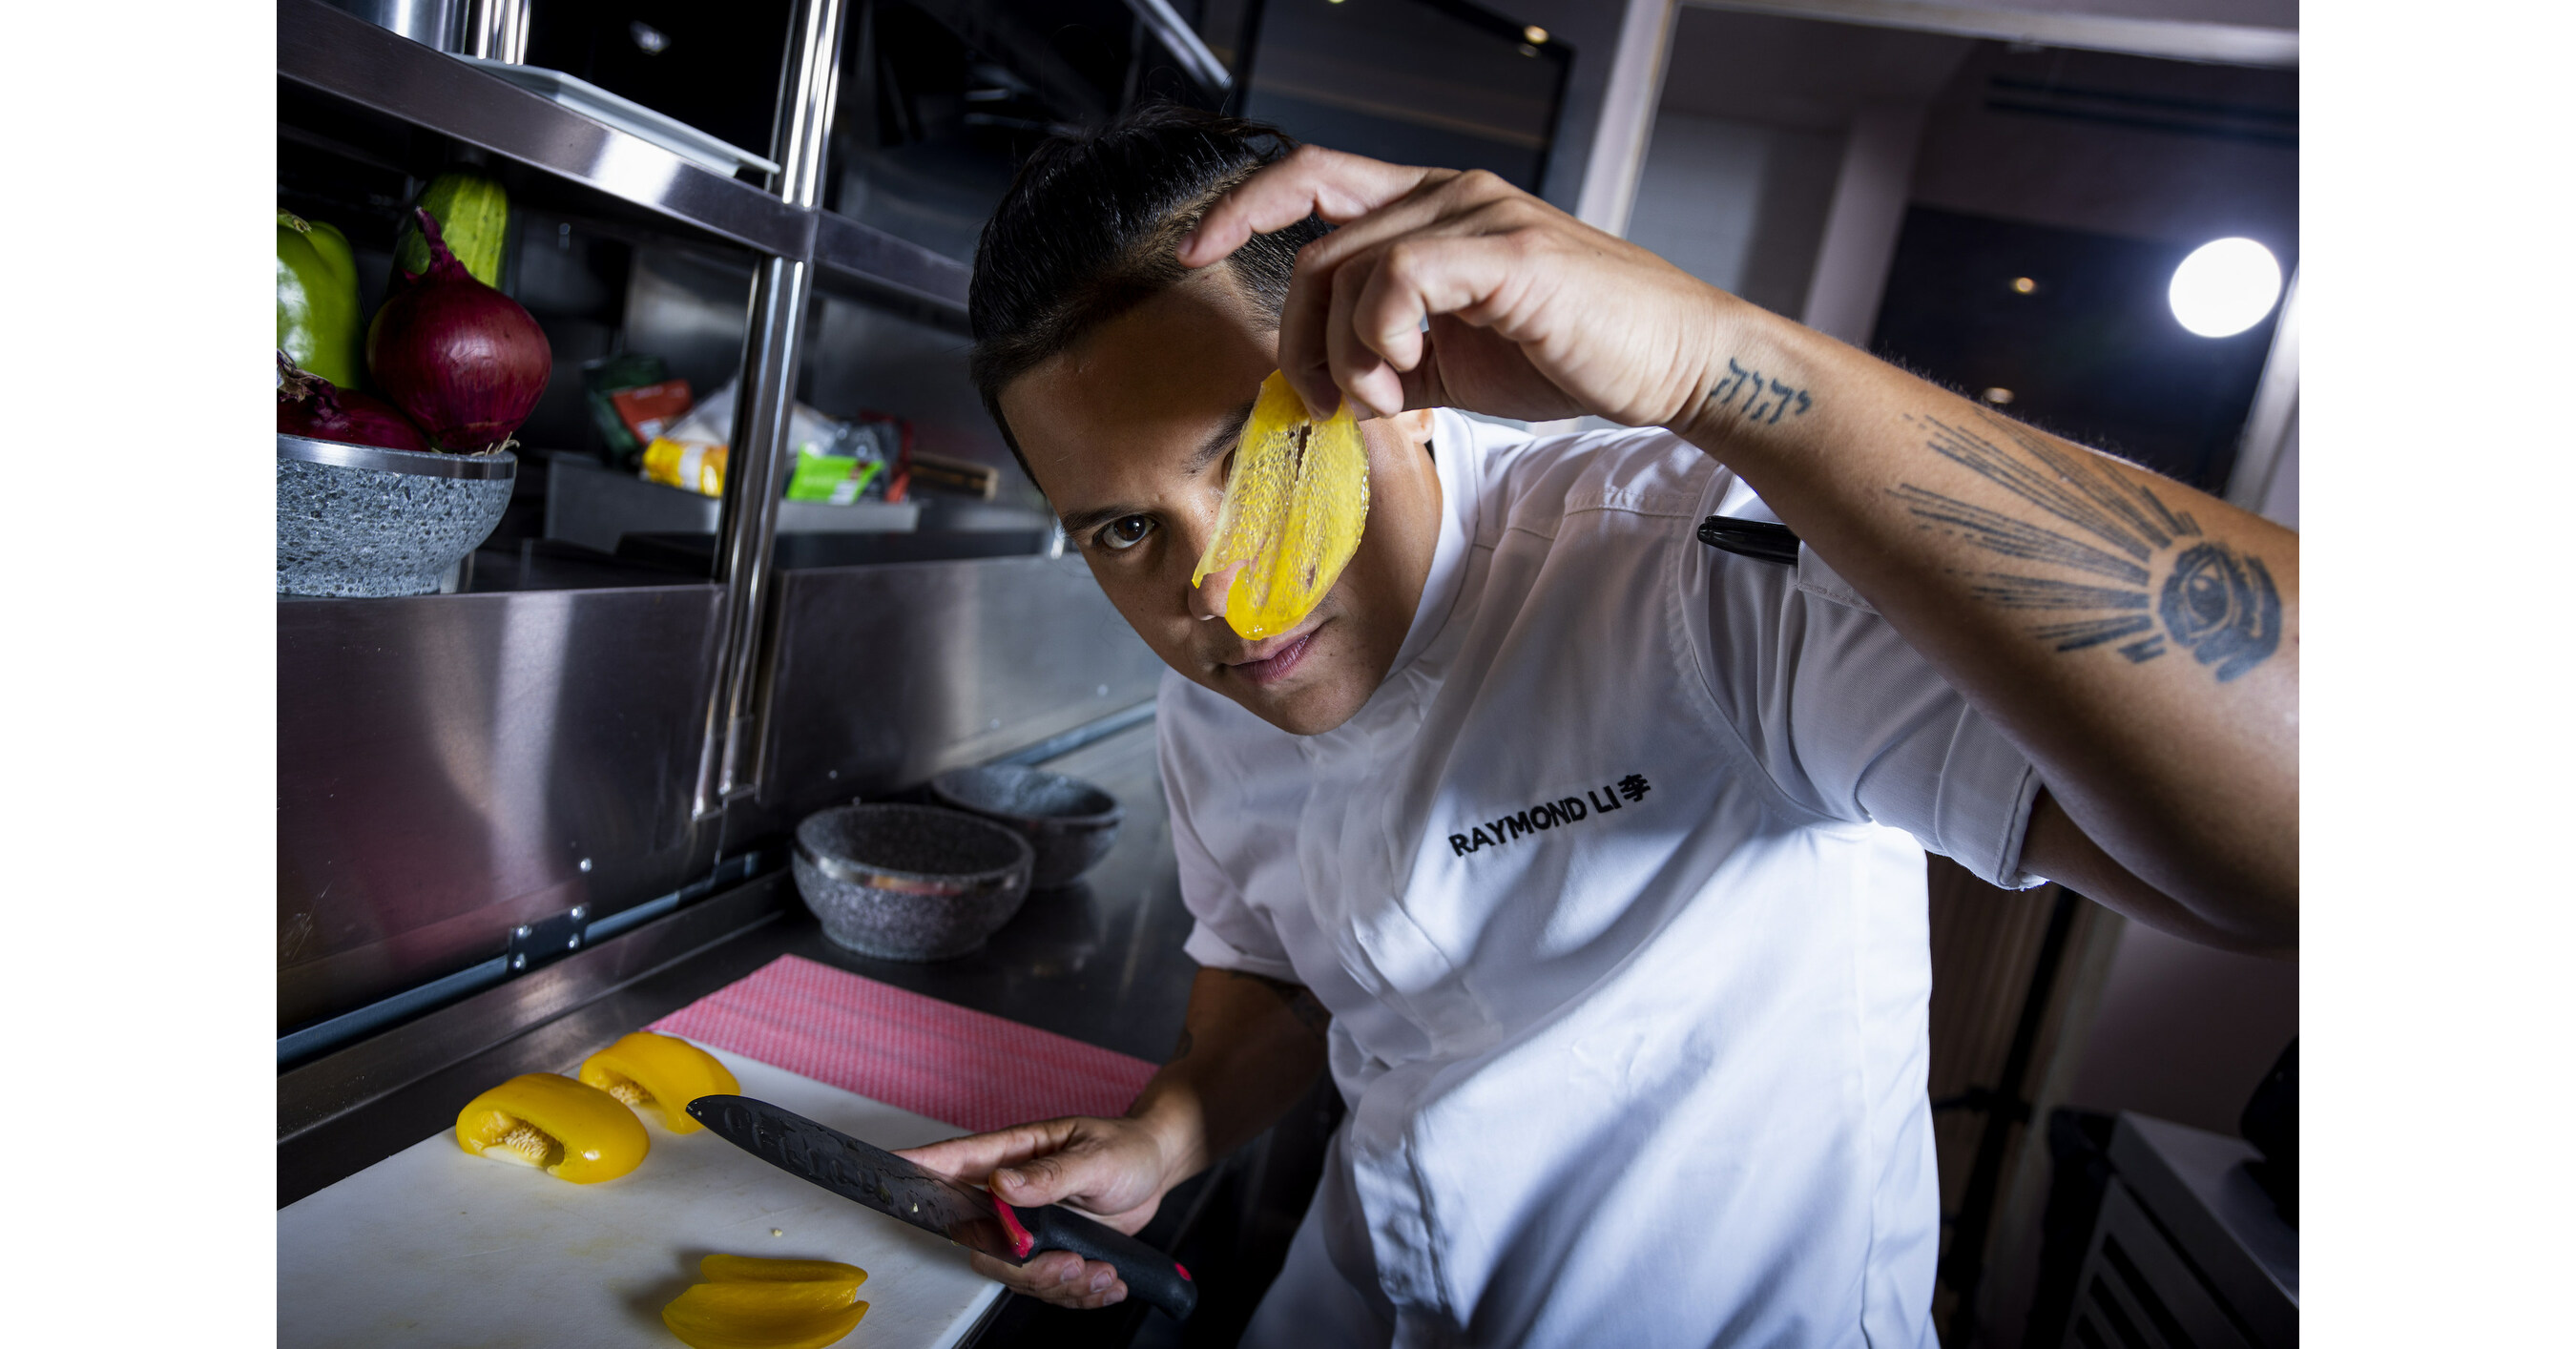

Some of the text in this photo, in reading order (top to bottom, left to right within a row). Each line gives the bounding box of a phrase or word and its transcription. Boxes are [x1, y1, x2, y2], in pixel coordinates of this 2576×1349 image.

[1711, 357, 1813, 425] יהוה
[1448, 774, 1652, 857] RAYMOND LI 李
